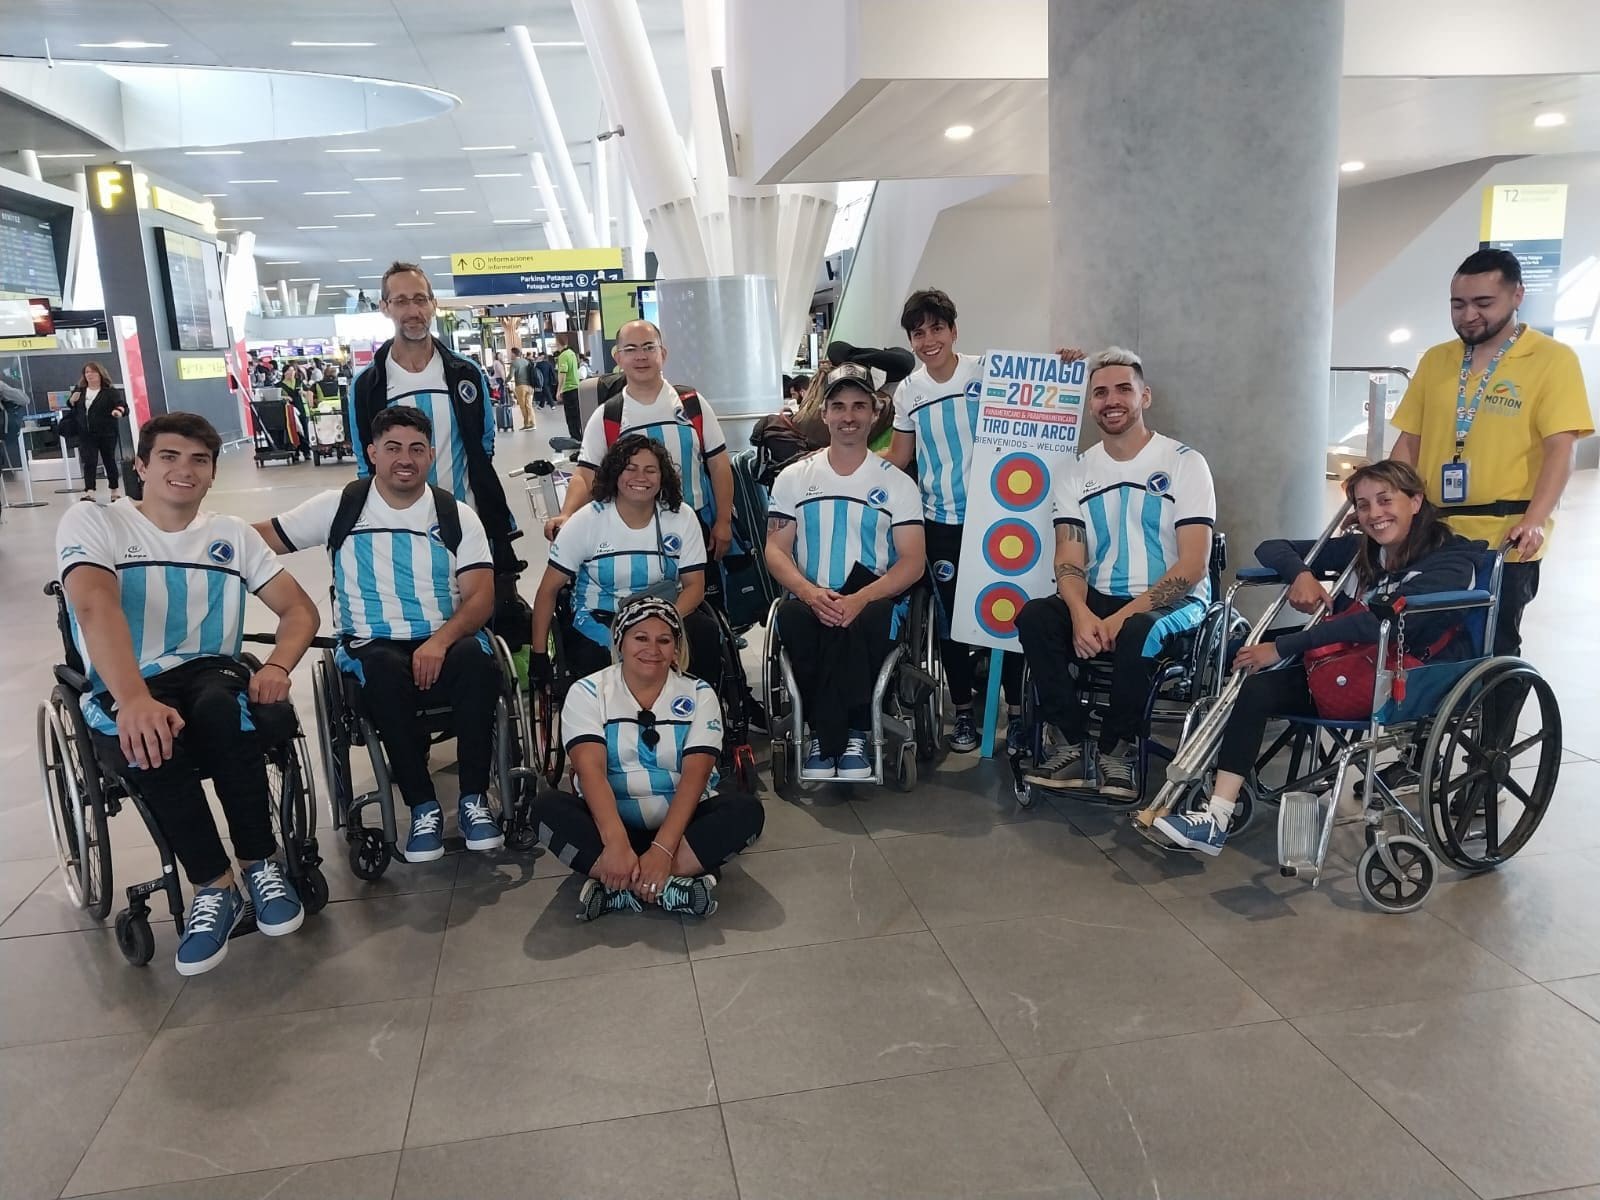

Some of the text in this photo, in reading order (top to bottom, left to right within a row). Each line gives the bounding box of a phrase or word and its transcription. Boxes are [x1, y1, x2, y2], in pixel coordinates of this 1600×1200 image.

[97, 171, 122, 208] F
[1504, 189, 1519, 202] T2
[520, 274, 545, 284] Parking
[989, 354, 1086, 385] SANTIAGO
[1007, 382, 1058, 408] 2022
[1484, 395, 1522, 409] MOTION
[983, 418, 1076, 441] TIRO CON ARCO
[975, 436, 1028, 449] BIENVENIDOS
[1037, 443, 1078, 454] WELCOME
